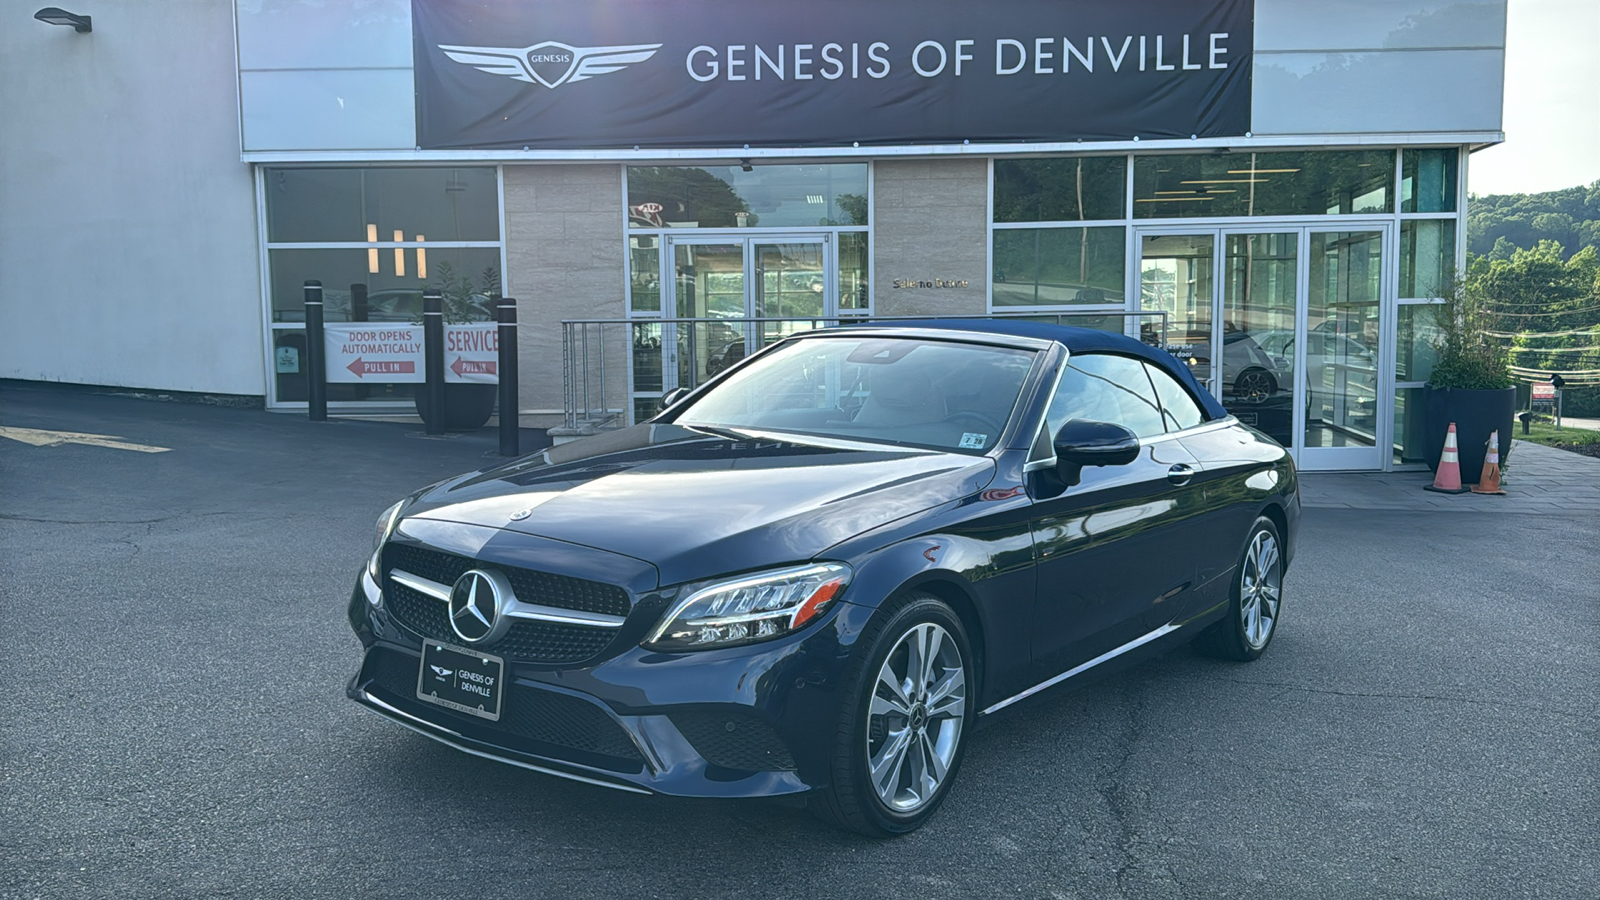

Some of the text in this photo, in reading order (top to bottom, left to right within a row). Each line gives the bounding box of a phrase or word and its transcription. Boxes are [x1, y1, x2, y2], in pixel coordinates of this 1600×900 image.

[531, 54, 570, 63] GENESIS
[686, 33, 1229, 82] GENESIS OF DENVILLE
[349, 331, 412, 342] DOOR OPENS
[447, 330, 498, 351] SERVICE
[341, 343, 421, 354] AUTOMATICALLY
[364, 363, 400, 372] PULL IN
[462, 362, 480, 372] PULL
[459, 670, 483, 683] GENESIS
[485, 677, 494, 686] OF
[462, 682, 490, 697] DENVILLE
